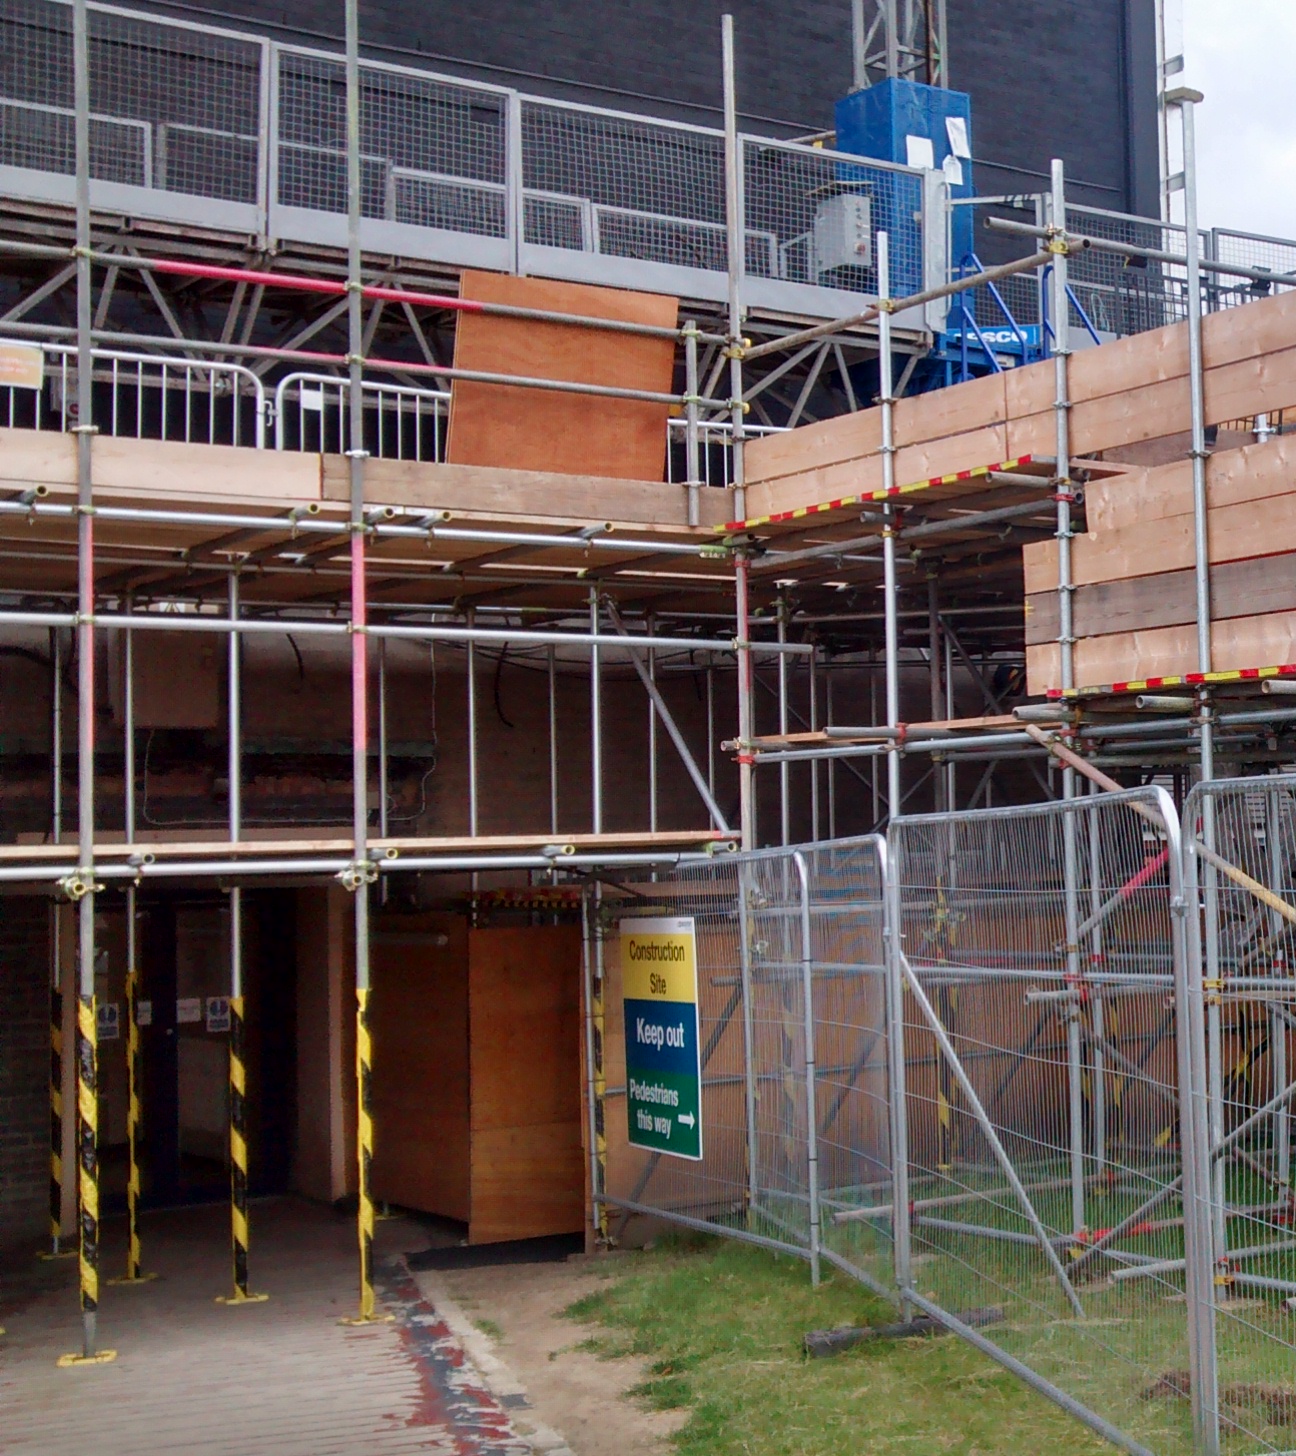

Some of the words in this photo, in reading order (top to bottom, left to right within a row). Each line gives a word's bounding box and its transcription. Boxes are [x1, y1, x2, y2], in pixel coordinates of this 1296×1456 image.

[629, 940, 685, 961] Construction
[649, 972, 667, 995] Site
[636, 1017, 664, 1051] Keep
[666, 1022, 685, 1048] out
[629, 1078, 679, 1107] Pedestrians
[637, 1108, 653, 1131] this
[653, 1116, 671, 1140] way
